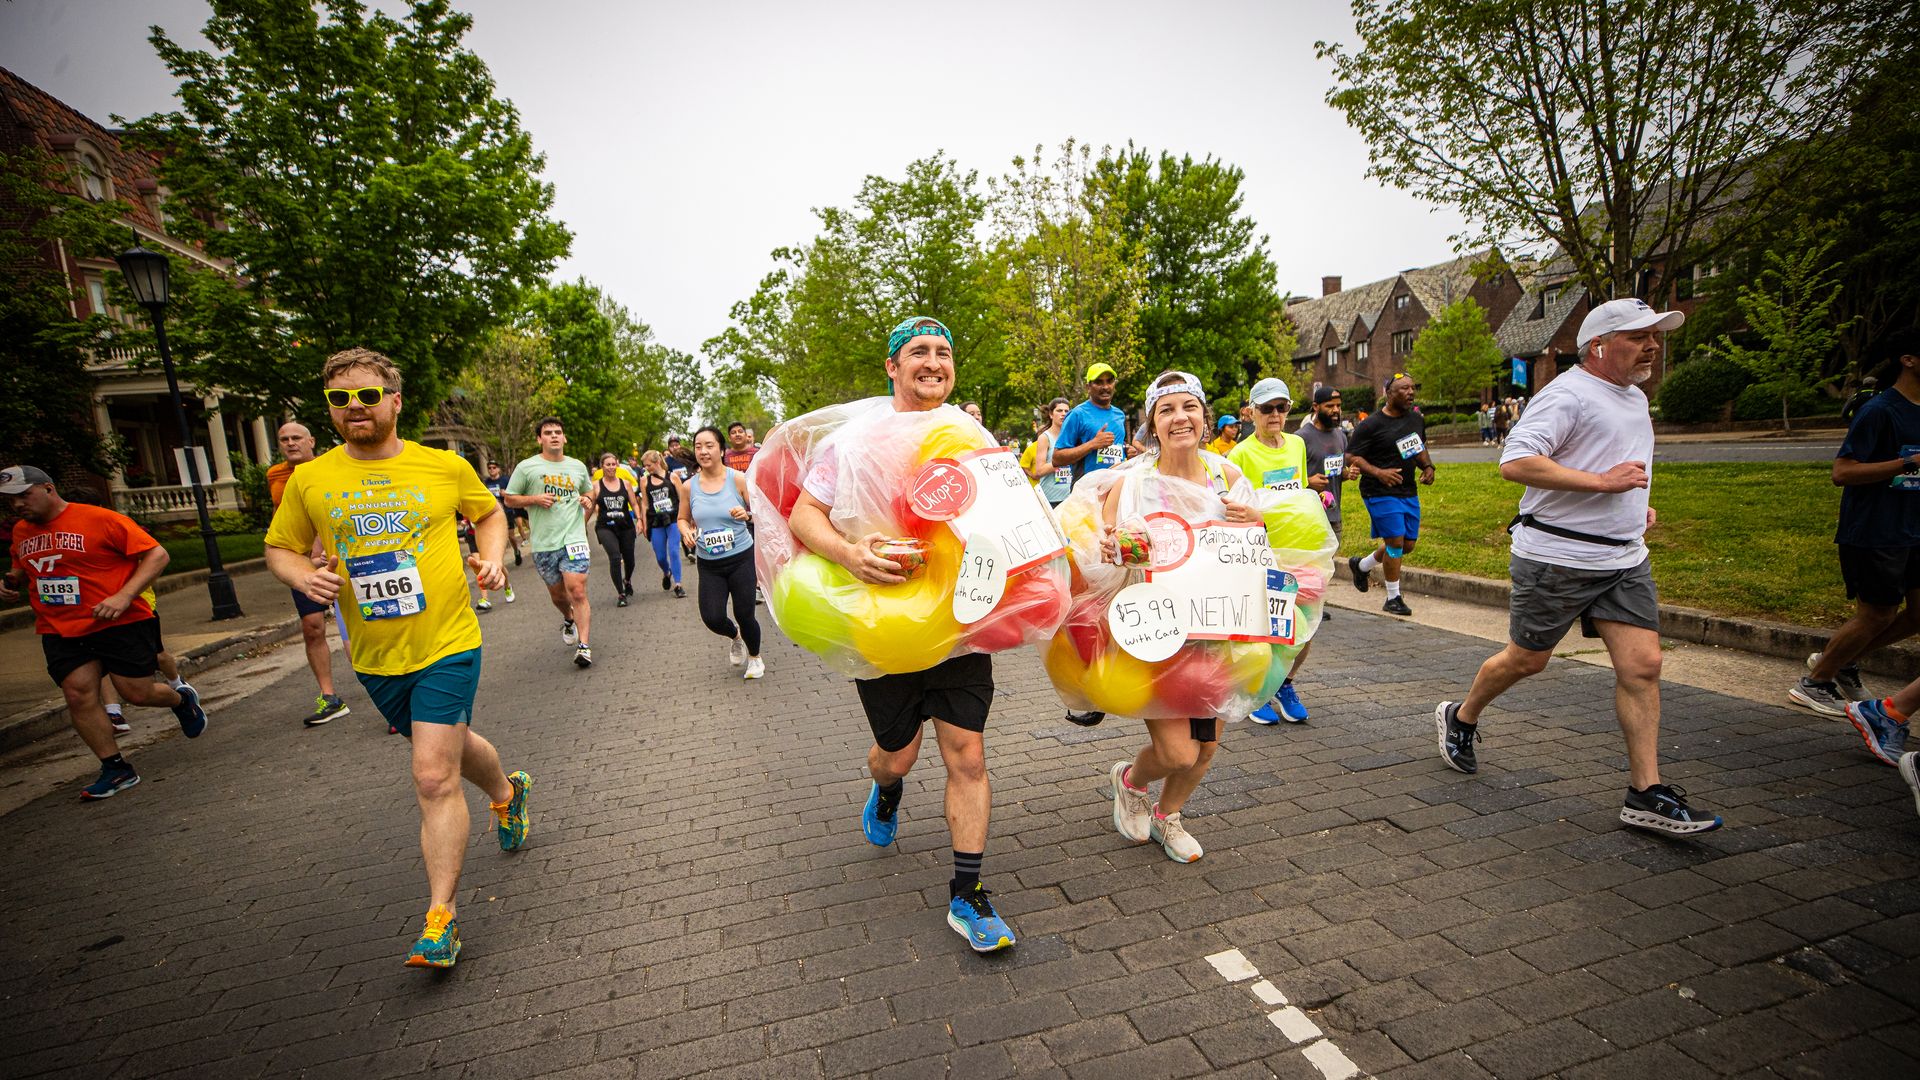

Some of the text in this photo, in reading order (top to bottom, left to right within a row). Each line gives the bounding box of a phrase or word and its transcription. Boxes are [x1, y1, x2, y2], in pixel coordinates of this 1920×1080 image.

[1401, 438, 1419, 450] 4720
[361, 479, 392, 487] Ukrops
[914, 475, 963, 511] Ukrop's
[349, 500, 408, 510] MONUMENT
[350, 510, 411, 537] 10K
[55, 532, 86, 553] TECH
[364, 538, 402, 547] AVENUE
[705, 534, 734, 546] 20418
[1199, 528, 1243, 547] Rainbow
[28, 554, 63, 573] VT
[1218, 545, 1273, 567] Grab & Go
[42, 583, 74, 594] 8183
[360, 576, 413, 600] 7166
[970, 588, 993, 604] Card
[1115, 598, 1176, 628] $5.99
[1269, 597, 1287, 616] 377
[1124, 627, 1180, 647] with Card
